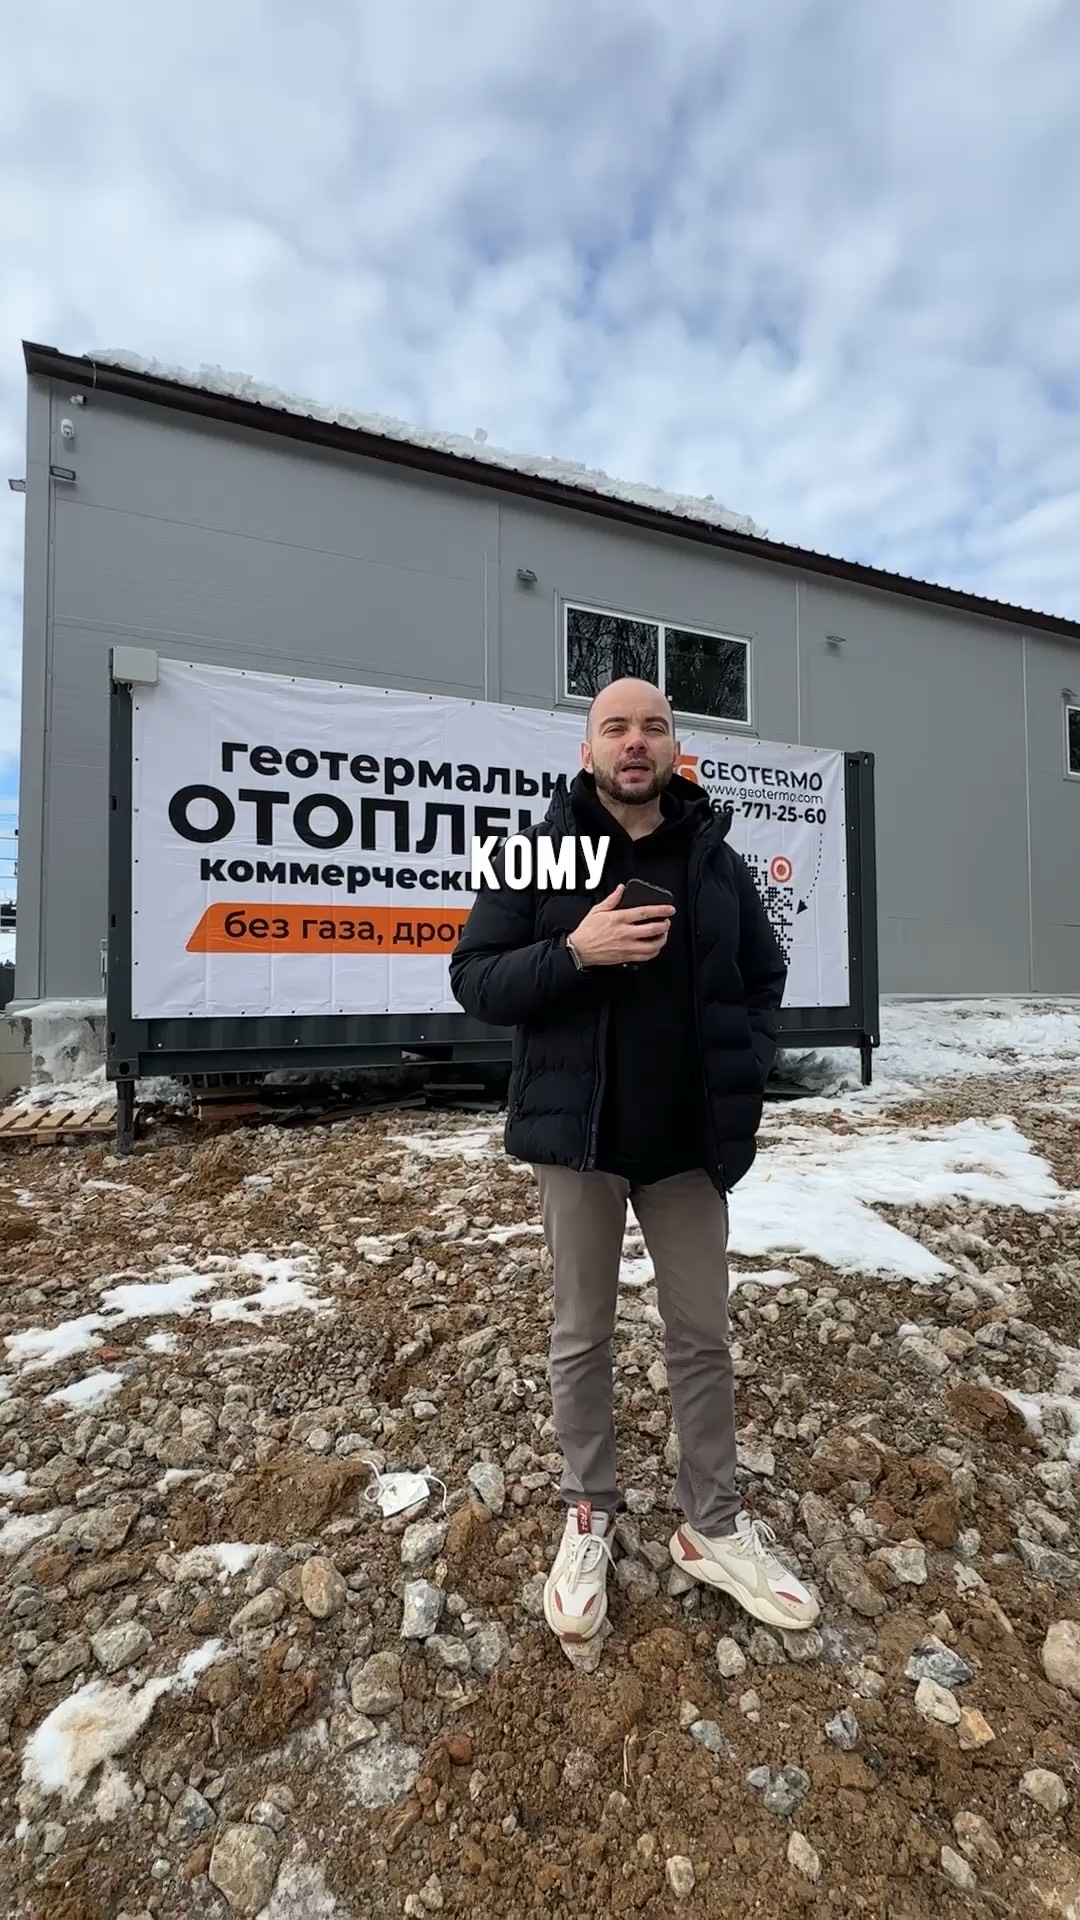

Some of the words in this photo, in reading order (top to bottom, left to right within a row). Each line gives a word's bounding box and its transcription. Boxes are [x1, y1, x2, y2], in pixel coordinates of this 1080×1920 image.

[221, 742, 577, 799] геотермальн
[700, 759, 823, 791] GEOTERMO
[702, 784, 824, 804] www.geotermo.com
[224, 911, 290, 942] без
[302, 920, 384, 945] газа,
